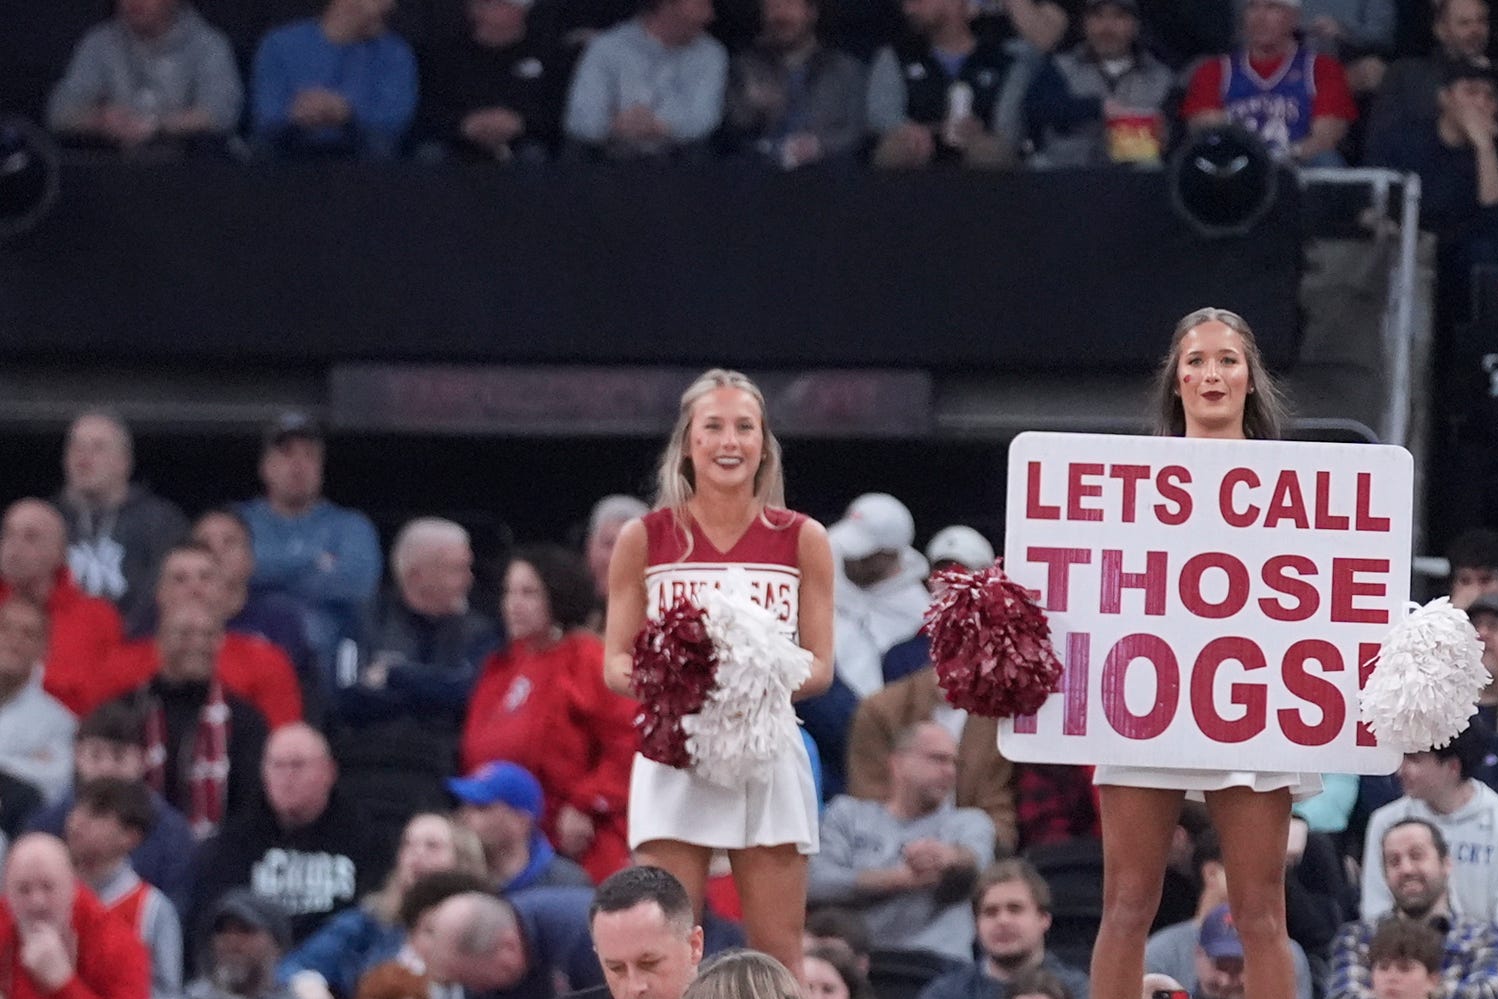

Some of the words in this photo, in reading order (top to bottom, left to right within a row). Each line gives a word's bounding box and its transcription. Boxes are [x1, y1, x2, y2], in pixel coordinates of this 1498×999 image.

[1025, 460, 1194, 526] LETS
[1218, 466, 1391, 532] CALL
[1026, 546, 1391, 625] THOSE
